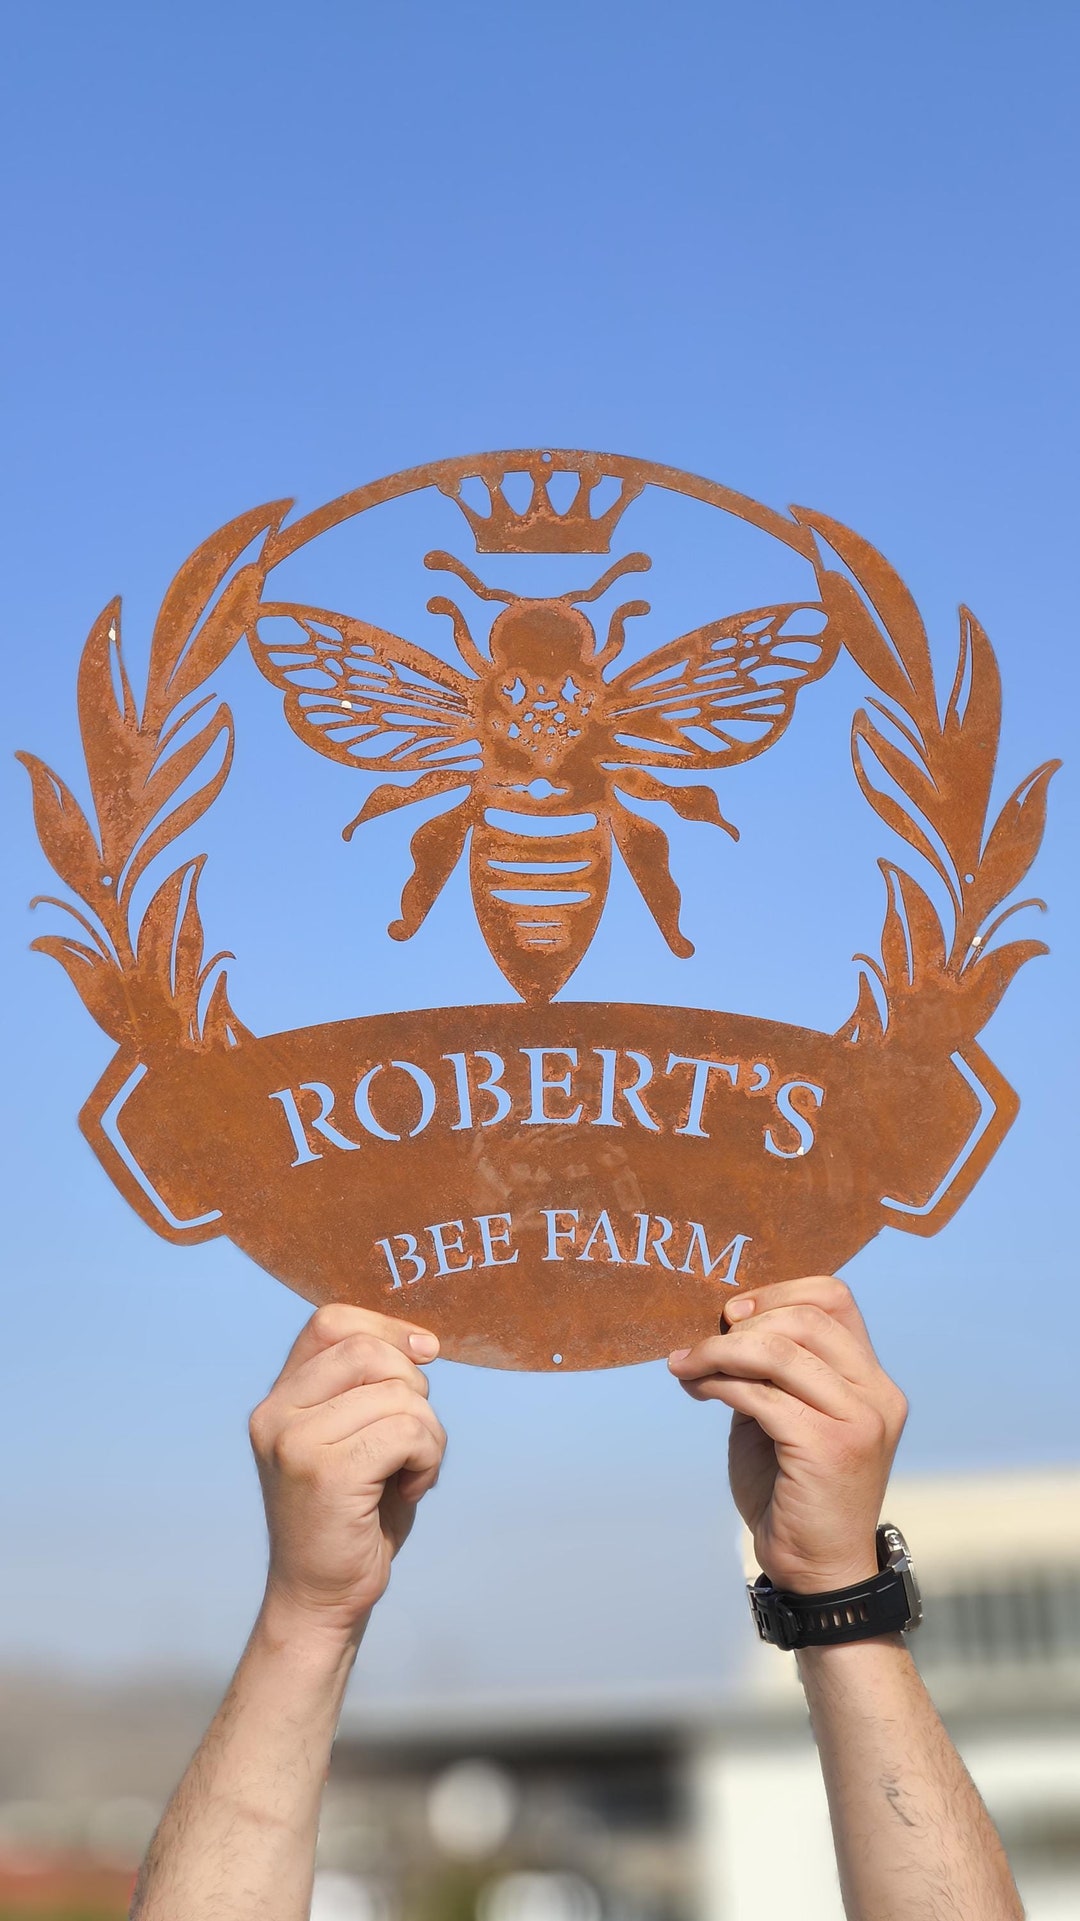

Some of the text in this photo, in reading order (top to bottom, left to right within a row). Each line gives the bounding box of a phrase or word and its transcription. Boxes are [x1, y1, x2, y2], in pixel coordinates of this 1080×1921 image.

[268, 1047, 825, 1167] ROBERT’S
[375, 1208, 753, 1291] BEE FARM
